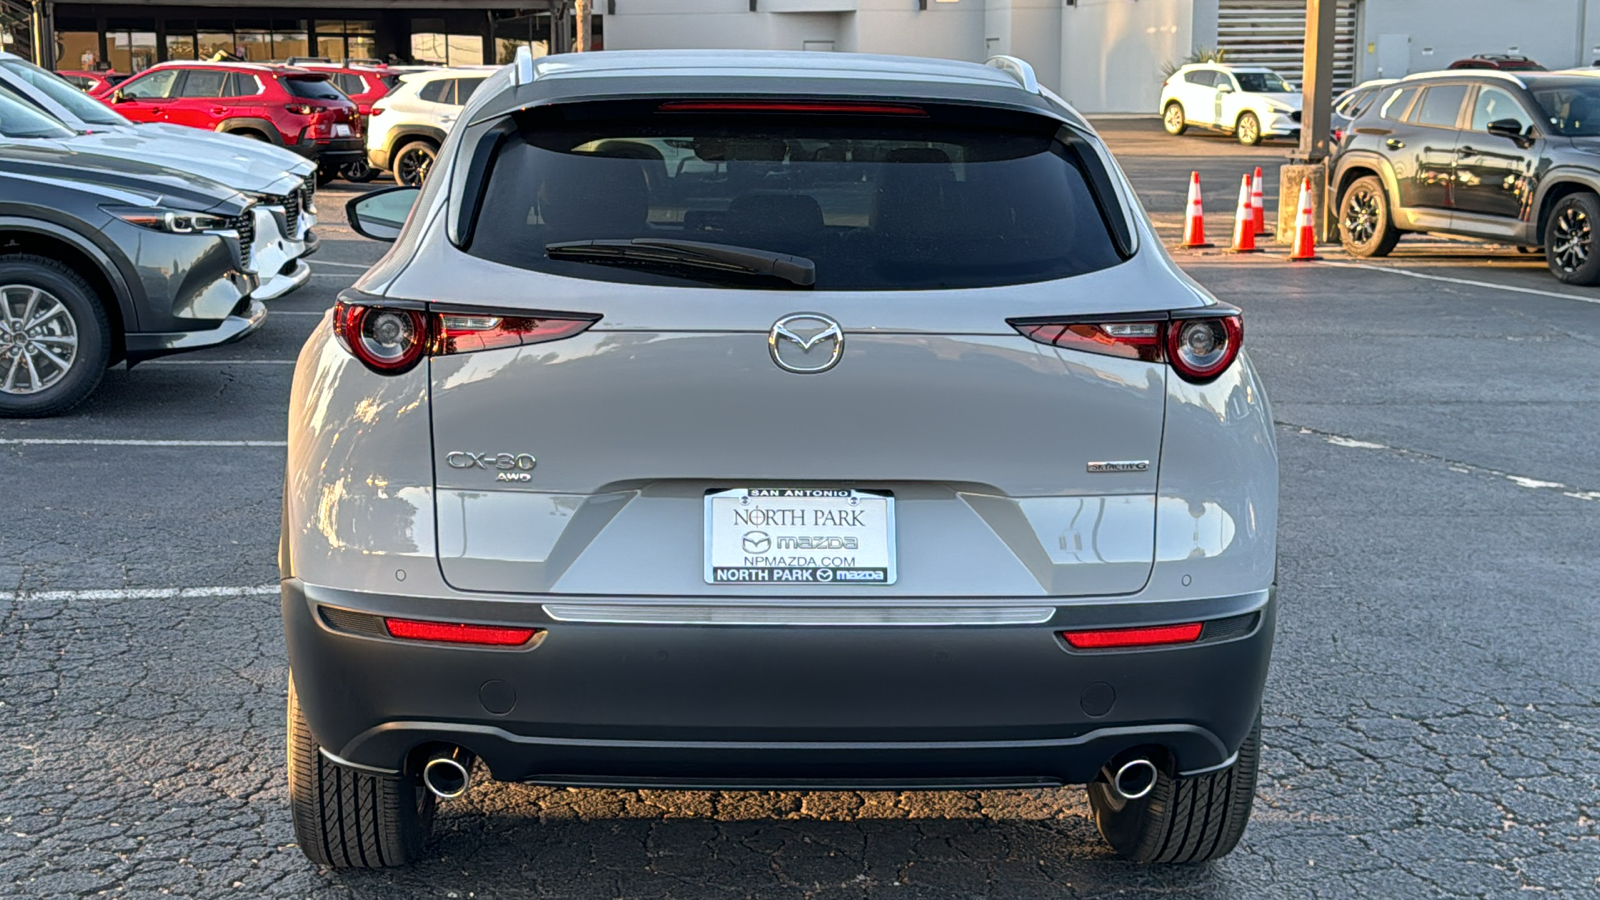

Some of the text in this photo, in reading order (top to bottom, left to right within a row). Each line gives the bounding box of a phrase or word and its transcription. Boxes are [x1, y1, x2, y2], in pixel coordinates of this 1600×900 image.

[446, 451, 537, 471] CX-30
[496, 472, 532, 482] AWD
[750, 489, 849, 497] SAN ANTONIO
[733, 508, 866, 527] NORTH PARK
[743, 556, 856, 567] NPMAZDA.COM
[716, 568, 769, 581] NORTH
[773, 569, 813, 581] PARK
